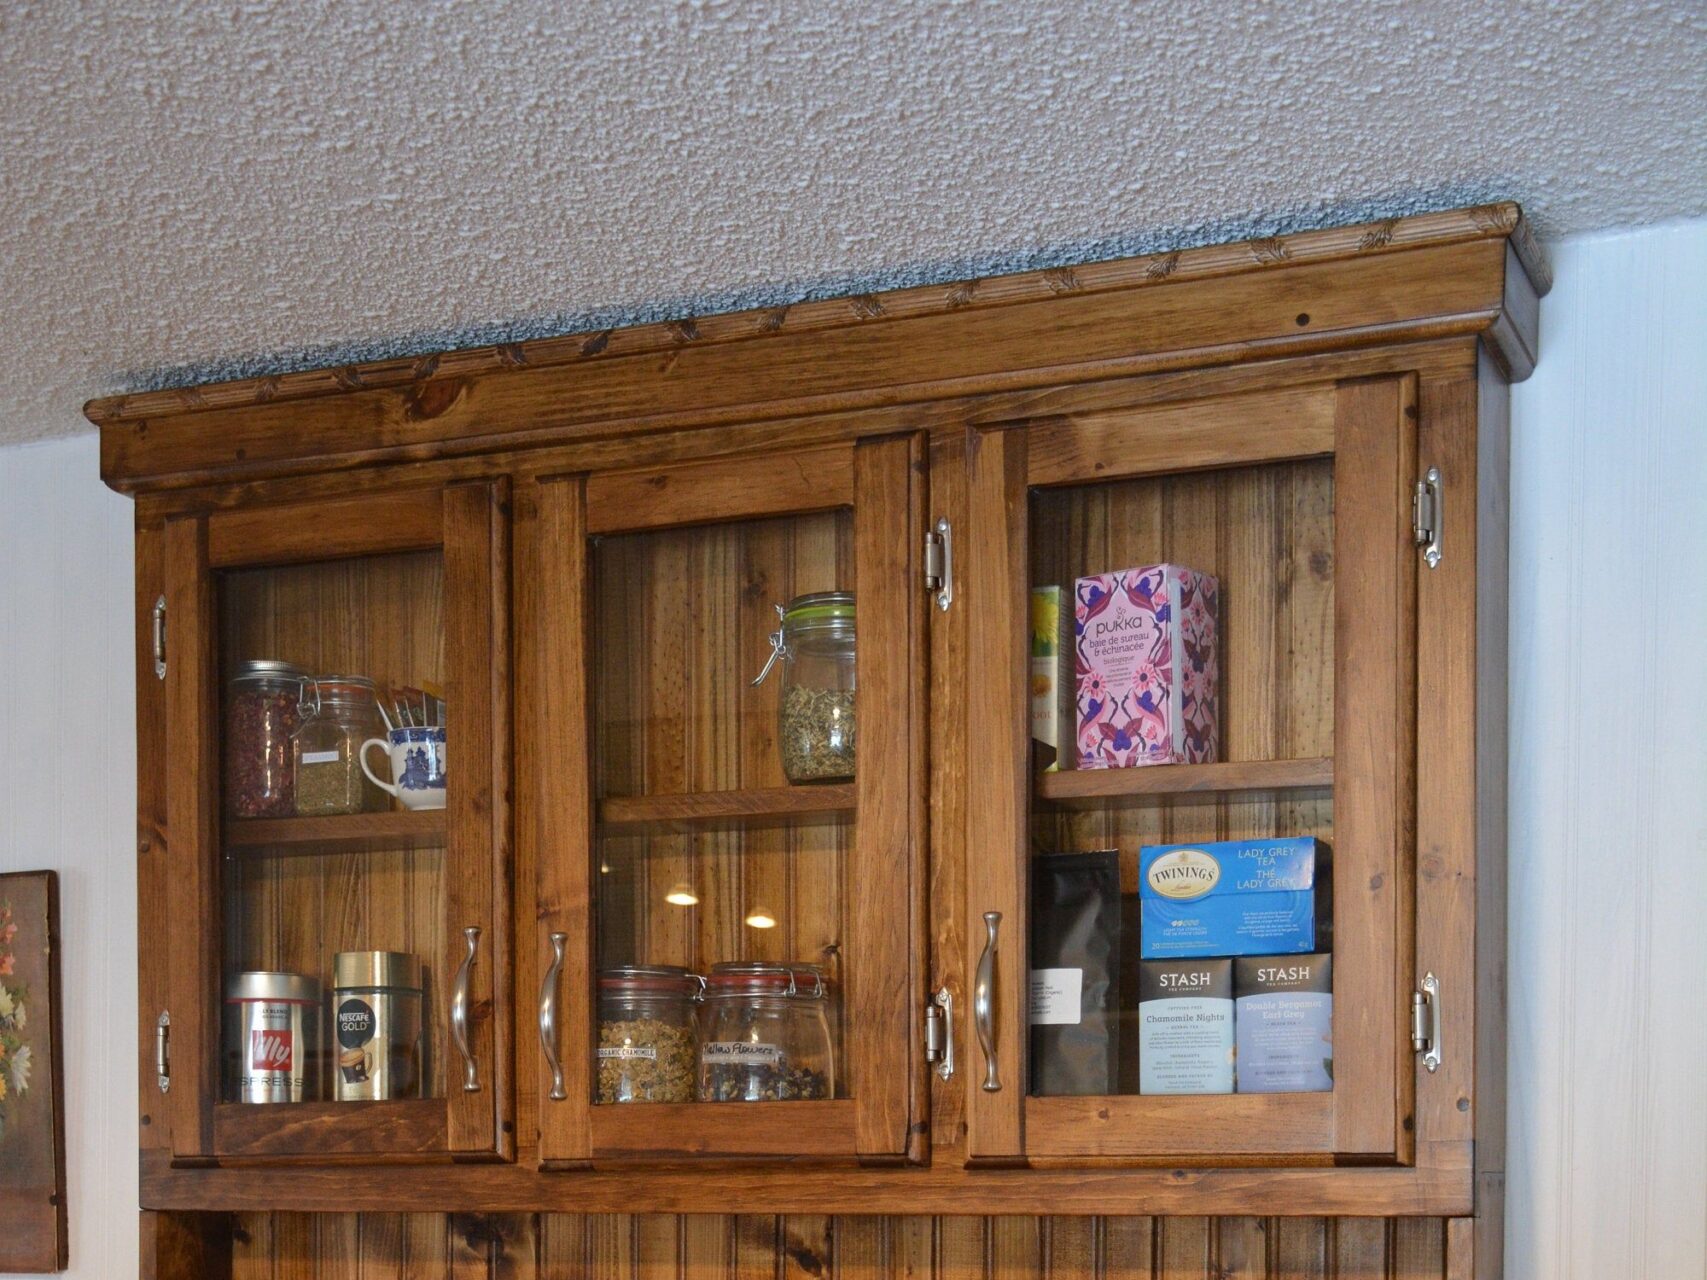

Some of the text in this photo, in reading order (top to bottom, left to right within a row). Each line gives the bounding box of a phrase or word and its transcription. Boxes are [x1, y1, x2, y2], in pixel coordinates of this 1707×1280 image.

[1096, 615, 1142, 638] pukka
[1090, 633, 1149, 648] baie de sureau
[1238, 847, 1295, 859] LADY GREY
[1257, 857, 1276, 866] TEA
[1153, 866, 1215, 883] TWININGS
[1256, 867, 1276, 879] THÉ
[1237, 879, 1265, 889] LADY
[1160, 972, 1210, 986] STASH
[1257, 966, 1310, 982] STASH
[1246, 1000, 1322, 1010] Double Bergamot
[1146, 1013, 1225, 1023] Chamomile Nights
[1263, 1010, 1305, 1019] Earl Grey
[342, 1022, 367, 1031] GOLD
[252, 1034, 290, 1067] illy
[732, 1042, 773, 1055] Flowers
